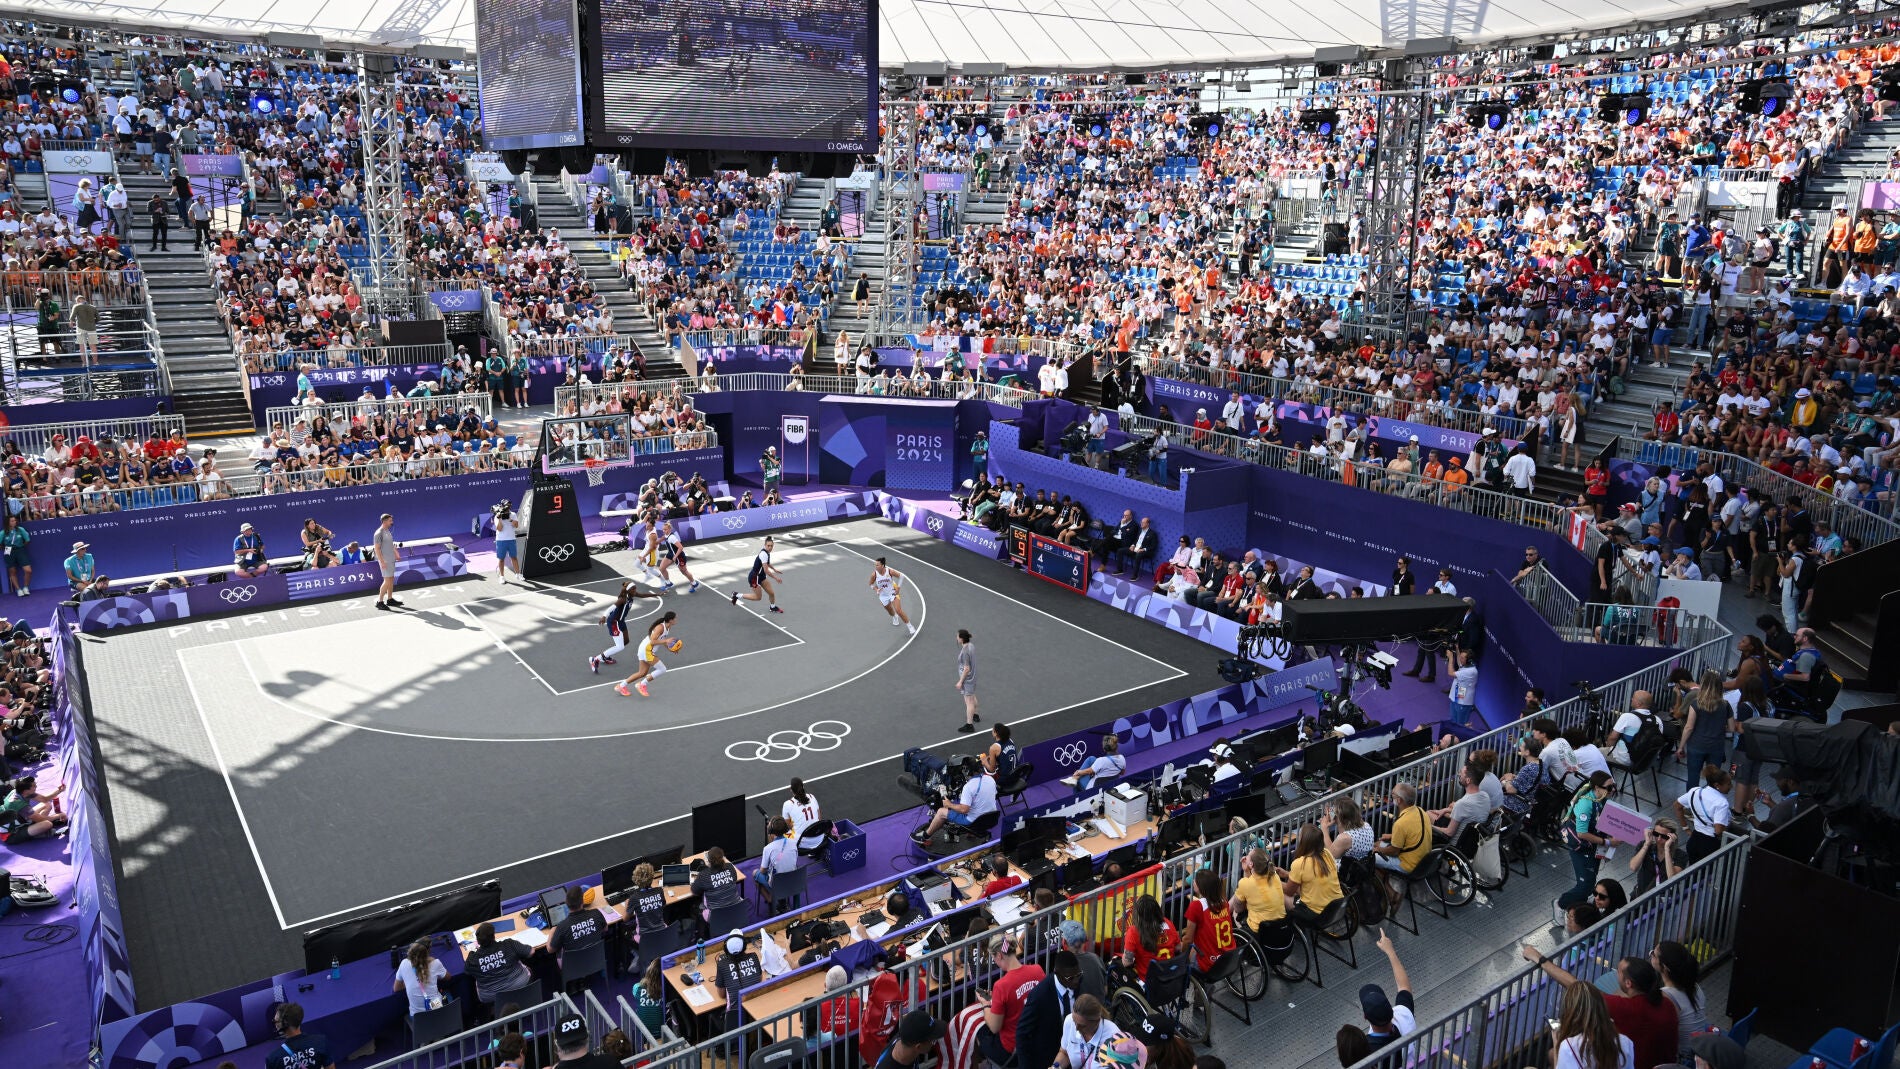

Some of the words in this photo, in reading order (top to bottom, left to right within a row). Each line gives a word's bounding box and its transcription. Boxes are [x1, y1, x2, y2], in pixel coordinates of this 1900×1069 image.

[1164, 384, 1190, 396] PARIS
[1194, 390, 1219, 401] 2024
[787, 424, 804, 433] FIBA
[1440, 434, 1474, 448] PARI
[897, 448, 941, 462] 2024
[554, 496, 562, 508] 9
[1018, 542, 1025, 557] 9
[1062, 551, 1073, 559] USA
[1038, 553, 1043, 562] 4
[1072, 565, 1078, 576] 6
[340, 573, 373, 584] 2024
[168, 606, 320, 638] PARIS
[802, 806, 814, 821] 11
[712, 876, 734, 888] 2024
[641, 901, 662, 912] 2024
[572, 926, 596, 940] 2024
[1215, 920, 1232, 948] 13
[481, 959, 506, 972] 2024
[729, 958, 754, 972] PRIS
